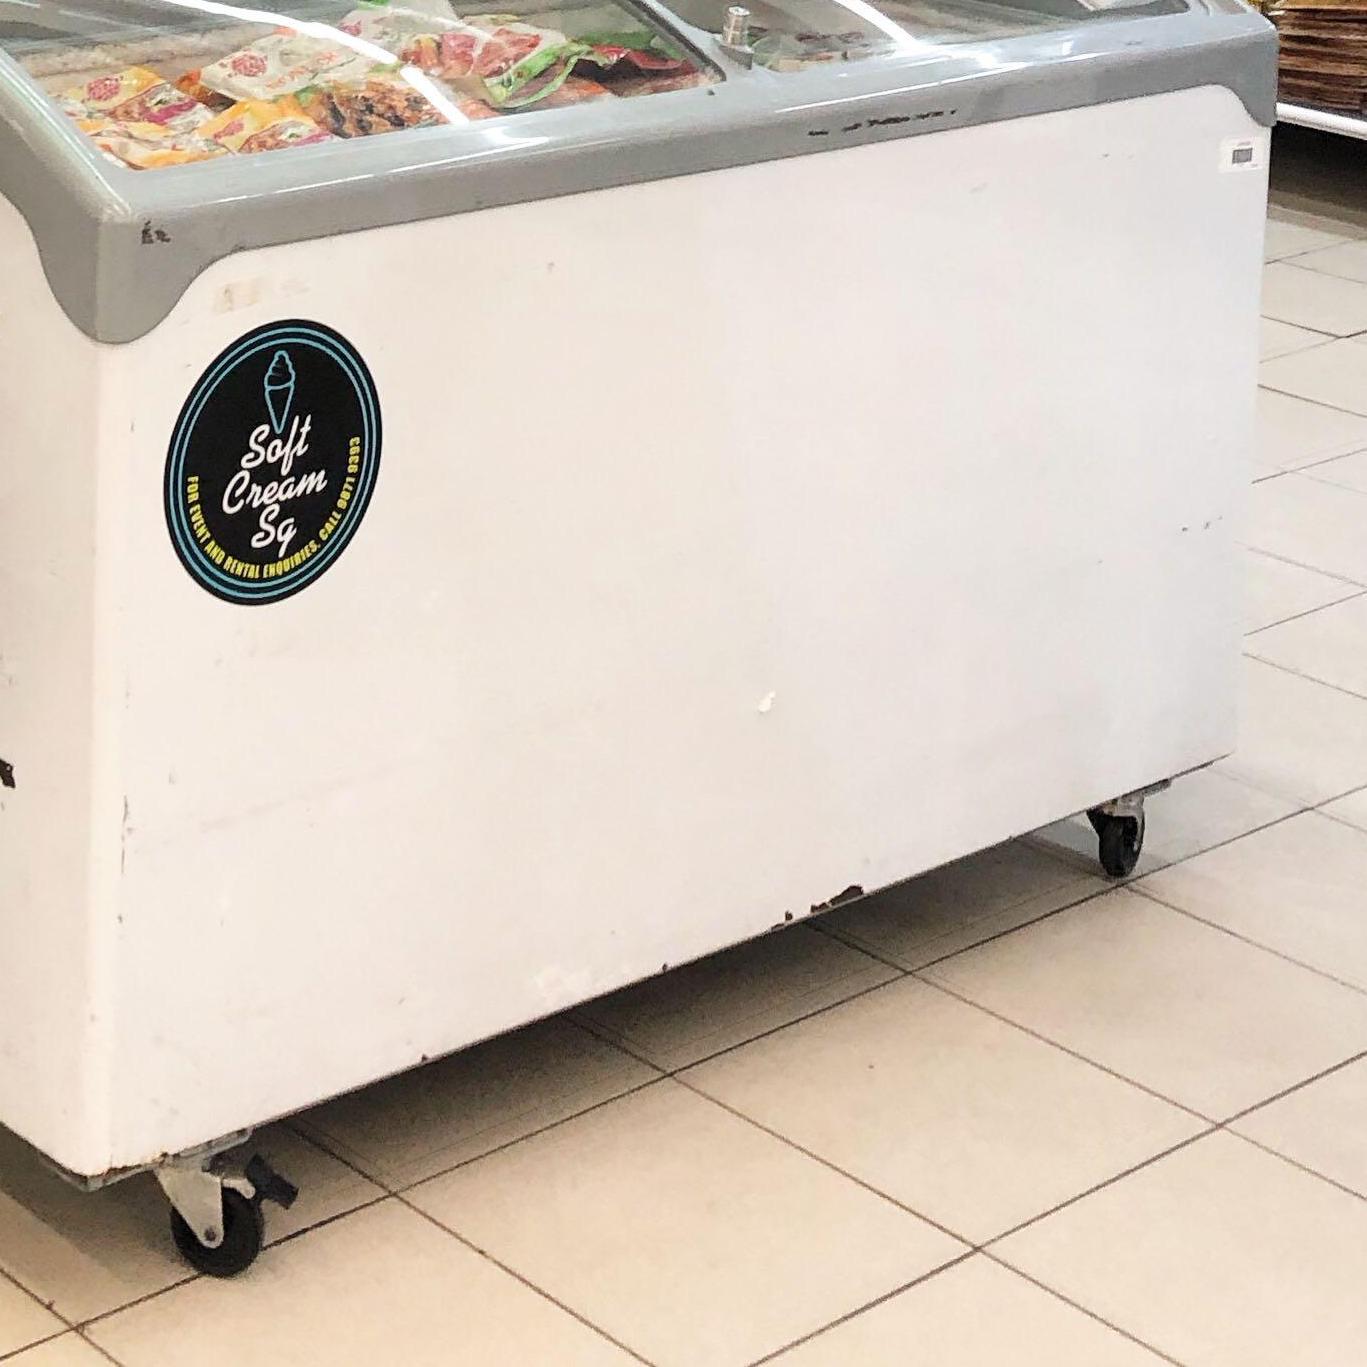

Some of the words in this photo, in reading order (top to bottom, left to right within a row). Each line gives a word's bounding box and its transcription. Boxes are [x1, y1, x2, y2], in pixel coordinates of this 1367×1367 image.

[240, 413, 313, 477] Soft
[186, 475, 200, 504] FOR
[221, 469, 328, 515] Cream
[189, 504, 212, 545] EVENT
[318, 510, 342, 542] CALL
[204, 539, 226, 564] AND
[222, 555, 261, 579] RENTAL
